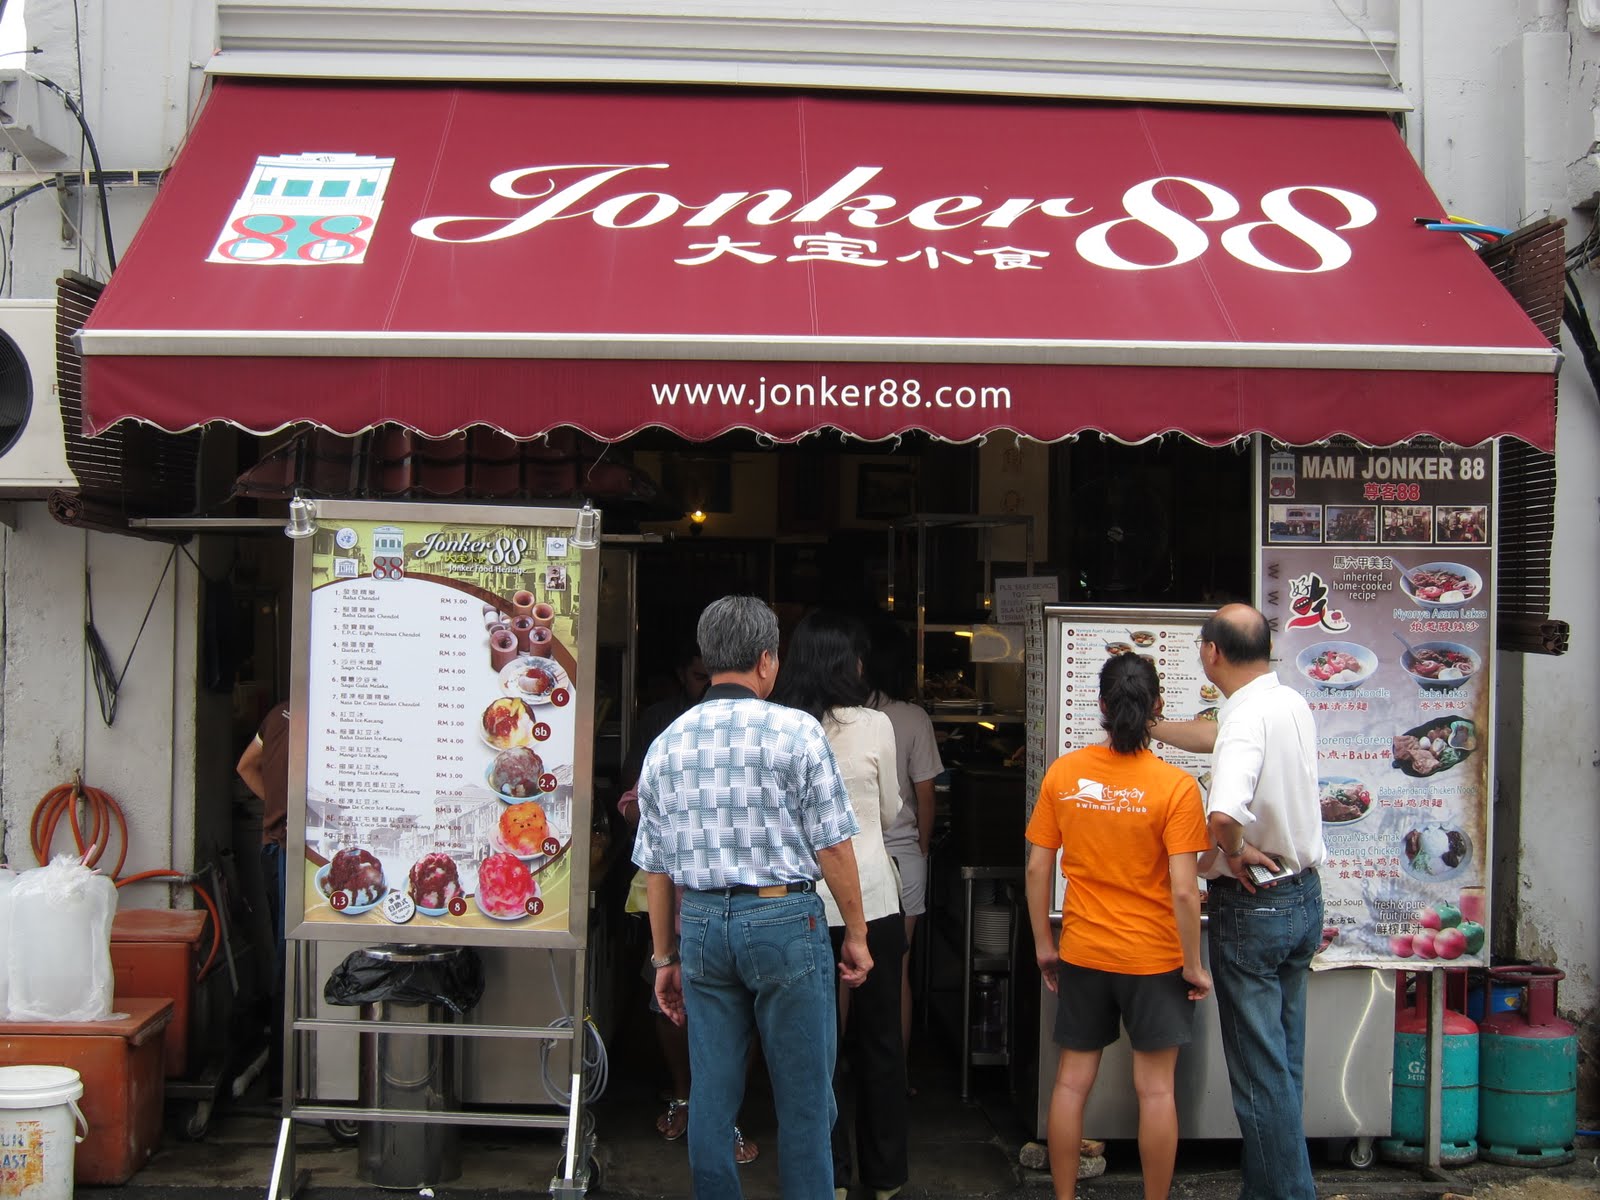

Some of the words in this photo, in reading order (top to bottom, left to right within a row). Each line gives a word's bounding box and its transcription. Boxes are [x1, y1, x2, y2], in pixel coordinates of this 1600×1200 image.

[411, 163, 1093, 244] Jonker
[1075, 176, 1378, 273] 88
[218, 213, 374, 263] 88
[674, 232, 1050, 269] 大宝小食
[651, 375, 1012, 414] www.jonker88.com
[1302, 455, 1355, 479] MAM
[1362, 456, 1454, 480] JONKER
[1460, 457, 1485, 480] 88
[1363, 482, 1421, 501] 尊客88
[416, 532, 494, 558] Jonker
[489, 537, 527, 565] 88
[1333, 556, 1393, 570] 馬六甲美食
[449, 565, 473, 573] Jonker
[1343, 572, 1382, 581] inherited
[1333, 582, 1392, 590] home-cooked
[1349, 592, 1376, 601] recipe
[1393, 608, 1430, 621] Nyonya
[1432, 608, 1459, 619] Asam
[1460, 608, 1487, 619] Laksa
[557, 693, 563, 702] 6
[1330, 689, 1355, 700] Soup
[1357, 688, 1390, 698] Noodle
[1419, 688, 1441, 698] Baba
[1443, 688, 1468, 698] Laksa
[534, 728, 547, 736] 8b
[1379, 786, 1395, 795] Baba
[1398, 786, 1427, 796] Rendang
[1429, 786, 1456, 795] Chicken
[1076, 802, 1121, 813] swimming
[1373, 832, 1399, 842] Lemak
[543, 842, 557, 853] 8g
[1329, 846, 1366, 857] Rendang
[1367, 846, 1399, 856] Chicken
[455, 903, 460, 911] 8
[528, 902, 540, 913] 8f
[1344, 899, 1362, 908] Soup
[1374, 899, 1396, 910] fresh
[1398, 900, 1406, 910] &
[1406, 900, 1426, 911] pure
[1379, 910, 1397, 921] fruit
[1398, 911, 1420, 922] juice
